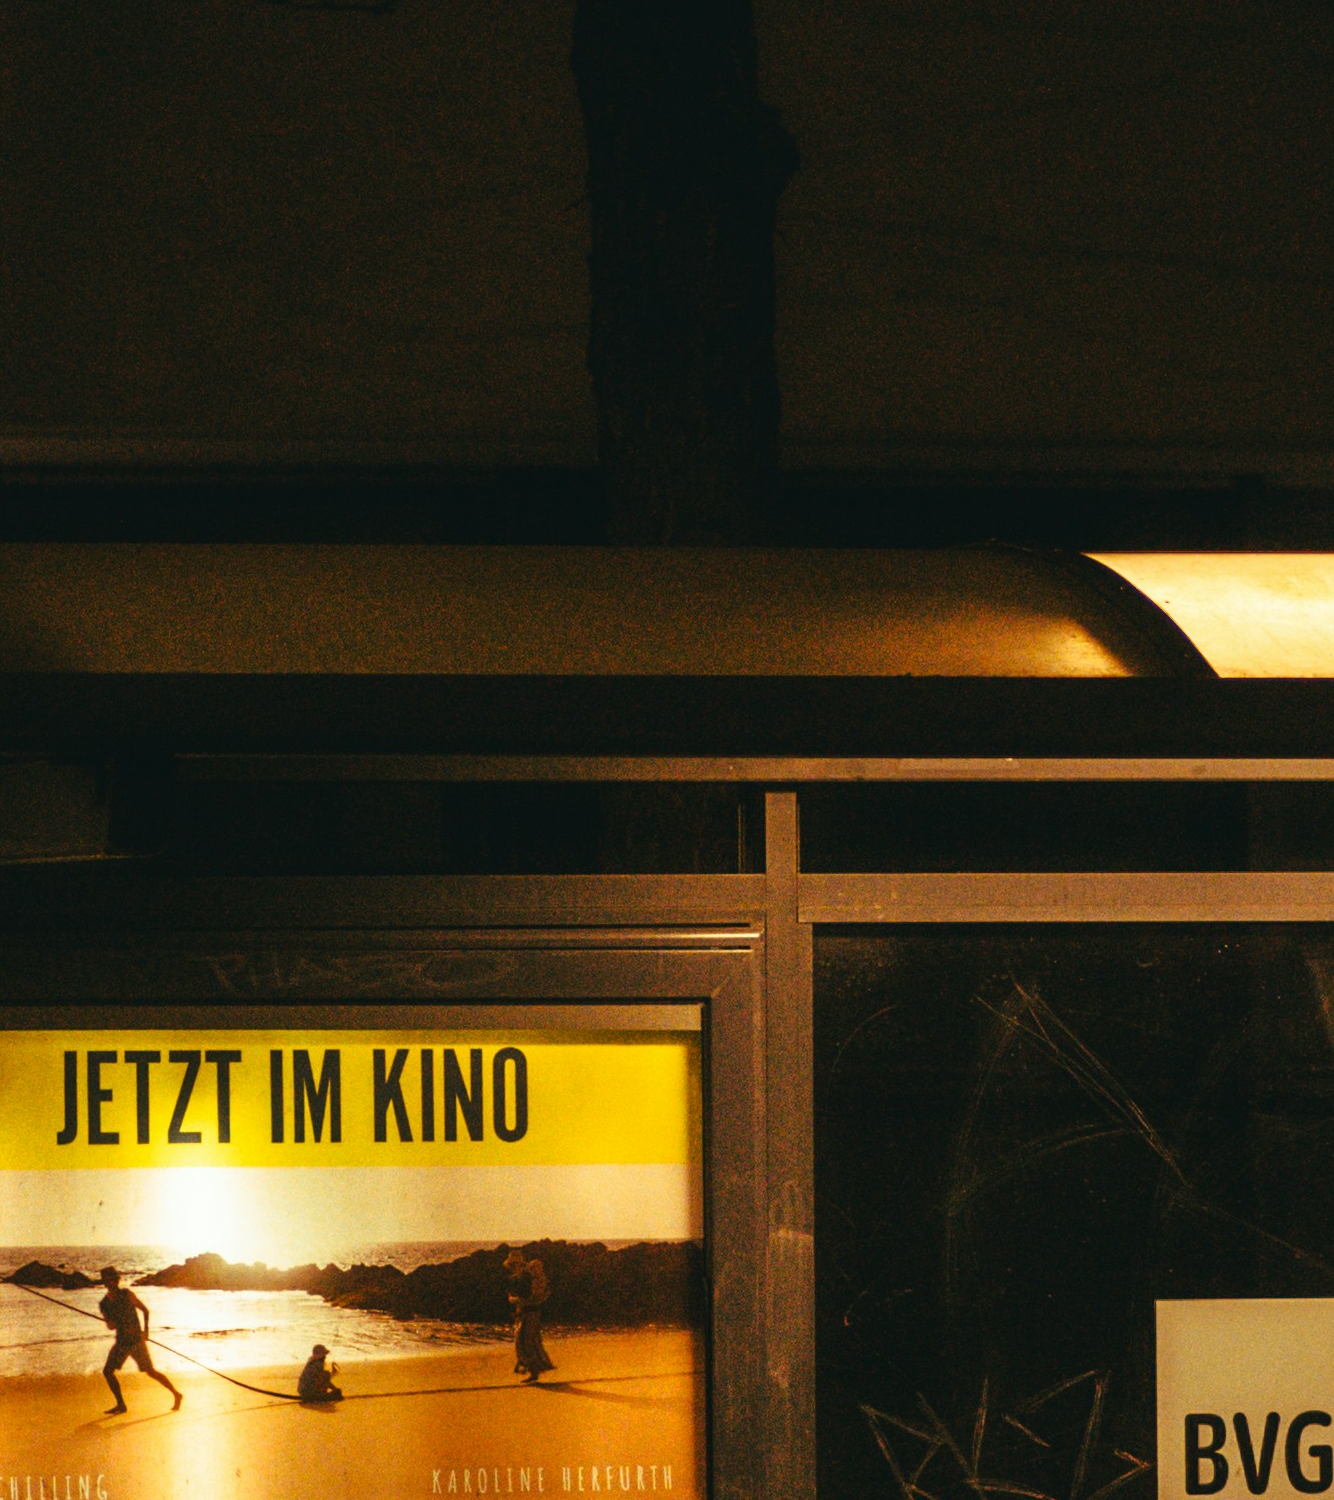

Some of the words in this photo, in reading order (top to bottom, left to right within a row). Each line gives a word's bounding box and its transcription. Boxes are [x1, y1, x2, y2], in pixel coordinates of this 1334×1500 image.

[56, 1049, 242, 1146] JETZT
[269, 1048, 343, 1144] IM
[372, 1046, 529, 1143] KINO
[432, 1467, 546, 1494] KAROLINE
[562, 1464, 673, 1492] HERFURTH
[1184, 1410, 1334, 1496] BVG
